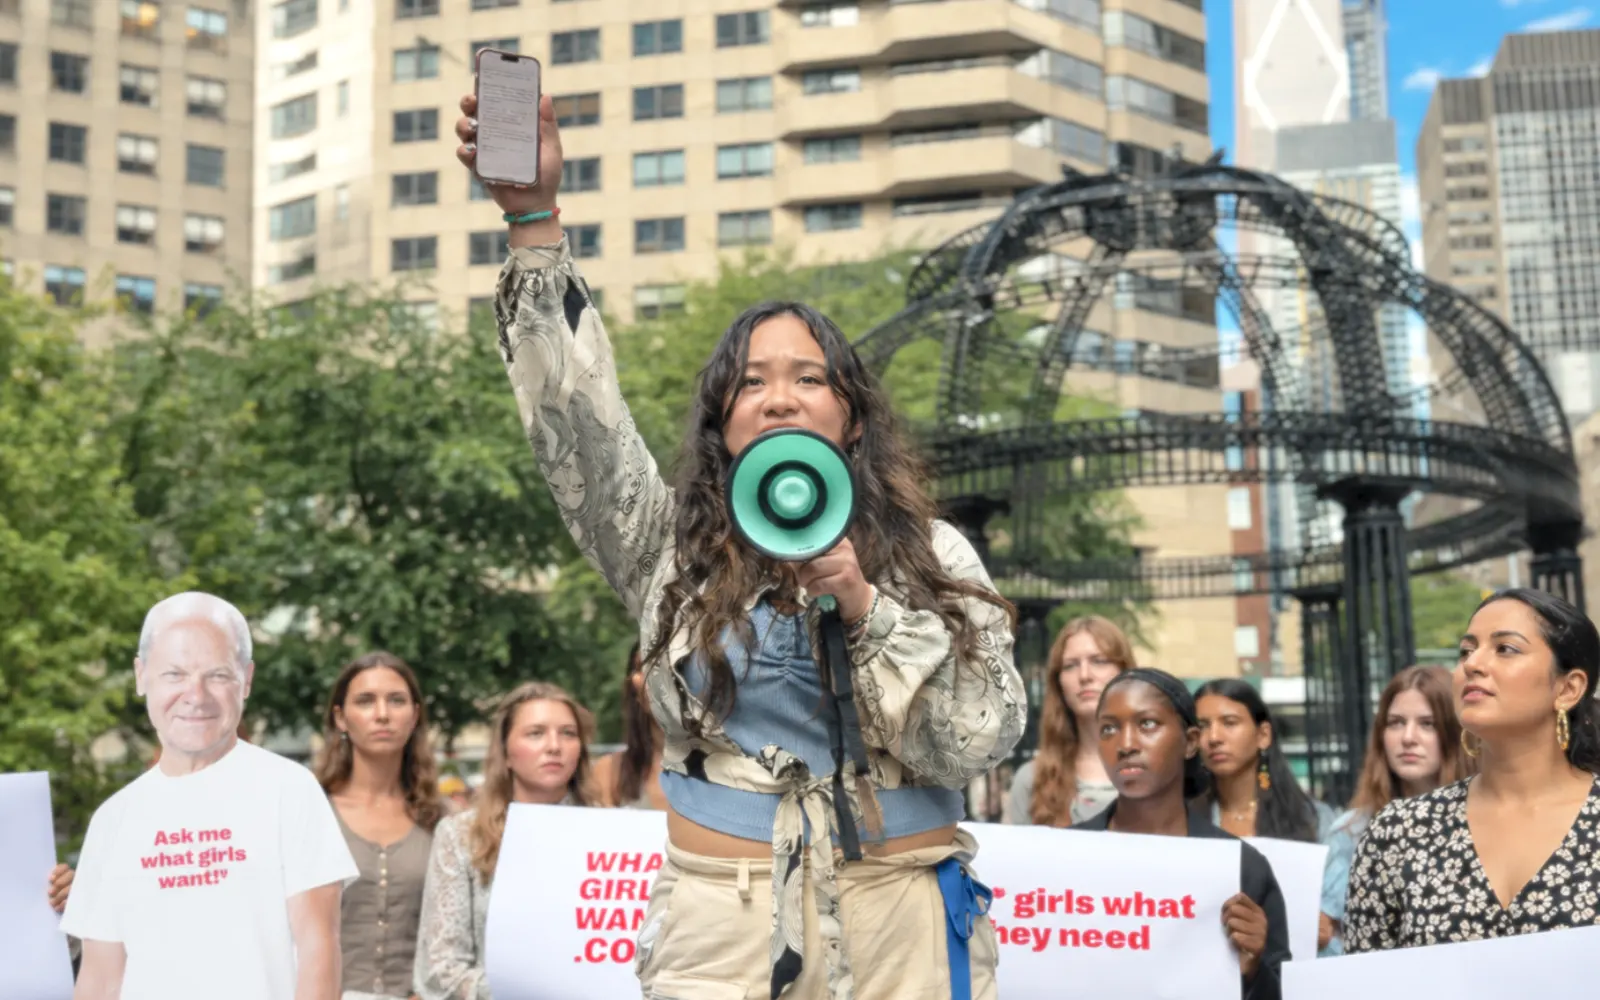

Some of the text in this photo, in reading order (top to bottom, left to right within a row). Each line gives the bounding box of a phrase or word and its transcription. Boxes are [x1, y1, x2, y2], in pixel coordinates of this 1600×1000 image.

[154, 828, 232, 846] Ask me
[140, 846, 247, 869] what girls
[586, 852, 664, 873] WHA
[579, 878, 651, 901] GIRL
[1014, 887, 1197, 920] girls what
[990, 919, 1151, 953] hey need
[573, 937, 637, 964] .CO
